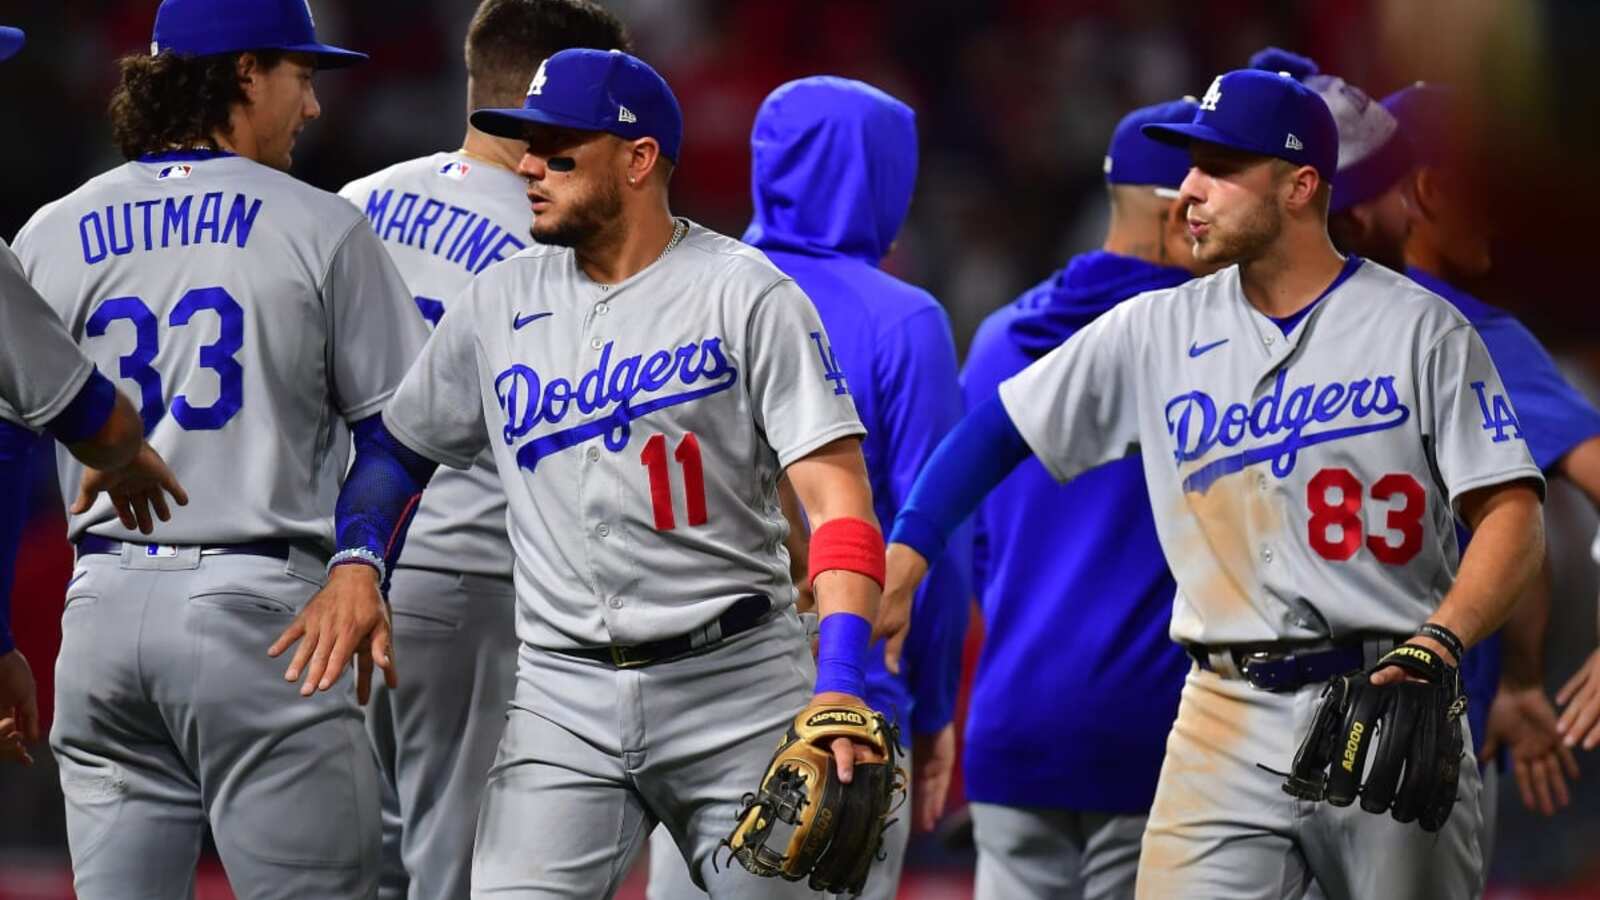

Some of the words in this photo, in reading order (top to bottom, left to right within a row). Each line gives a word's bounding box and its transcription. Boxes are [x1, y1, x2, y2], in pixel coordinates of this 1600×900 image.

[79, 191, 263, 265] OUTMAN
[85, 286, 244, 438] 33
[494, 336, 738, 472] Dodgers
[1165, 368, 1410, 492] Dodgers
[1471, 381, 1524, 442] LA
[641, 432, 707, 531] 11
[1307, 468, 1426, 565] 83
[1342, 721, 1364, 772] A2000
